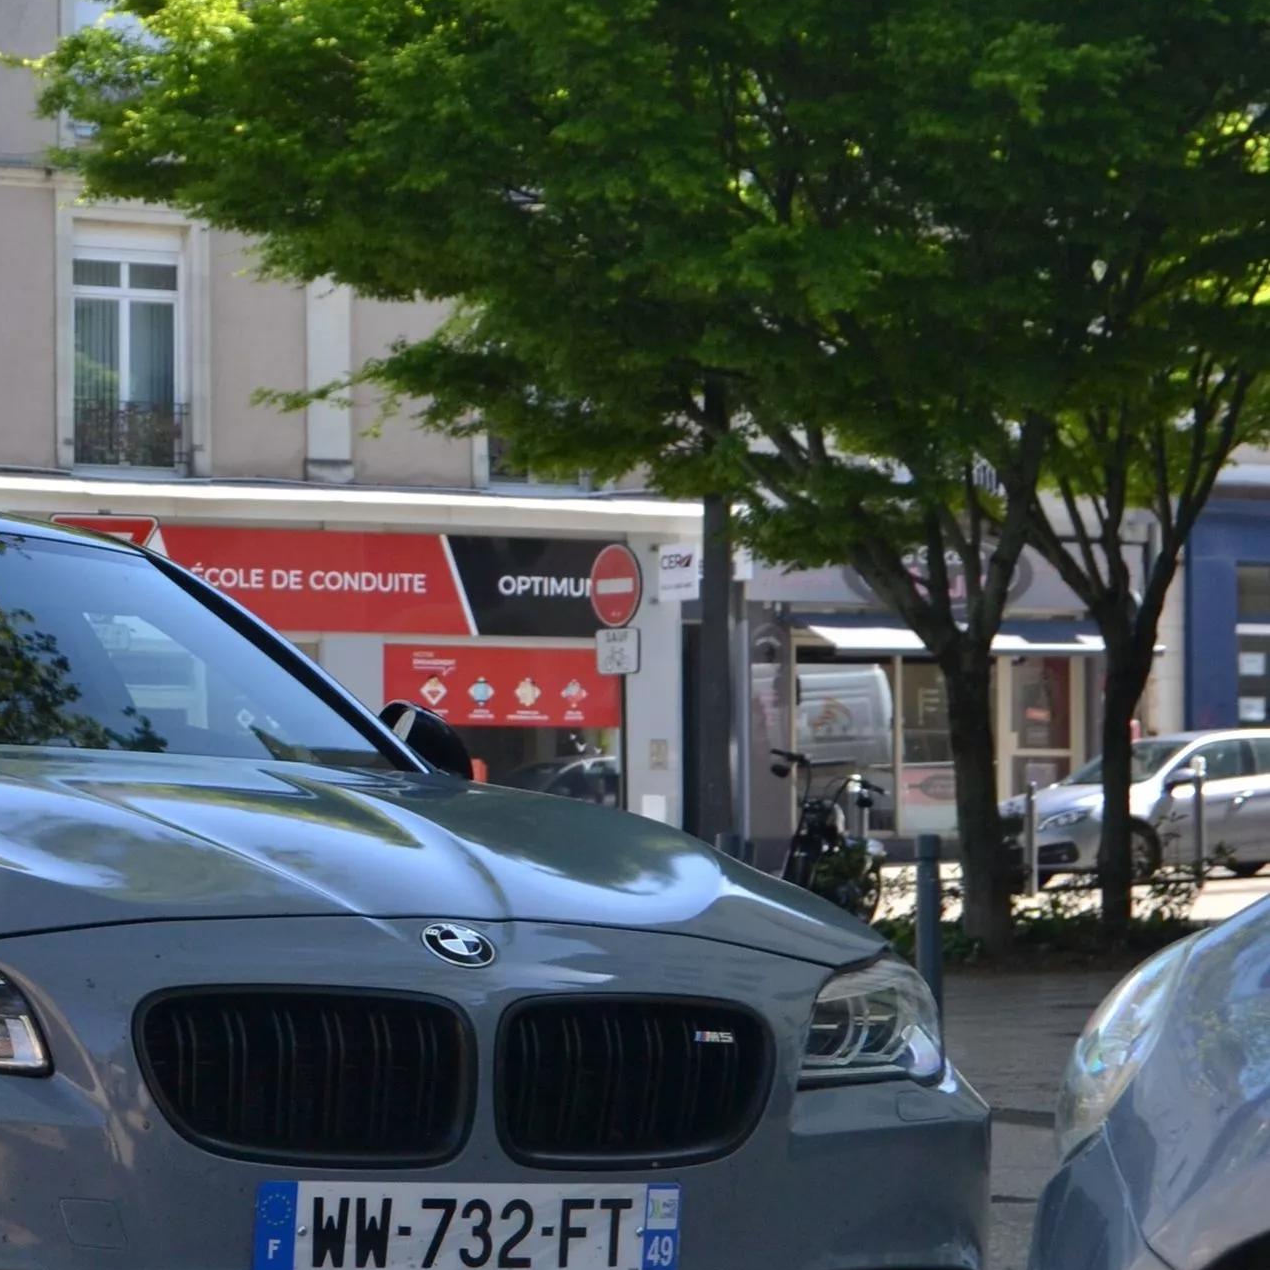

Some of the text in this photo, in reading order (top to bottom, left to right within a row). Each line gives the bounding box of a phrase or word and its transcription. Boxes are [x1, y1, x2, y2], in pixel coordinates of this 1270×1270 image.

[271, 569, 304, 590] DE
[309, 571, 427, 594] CONDUITE
[312, 1197, 633, 1269] WW-732-FT
[268, 1239, 281, 1259] F
[646, 1235, 674, 1267] 49
